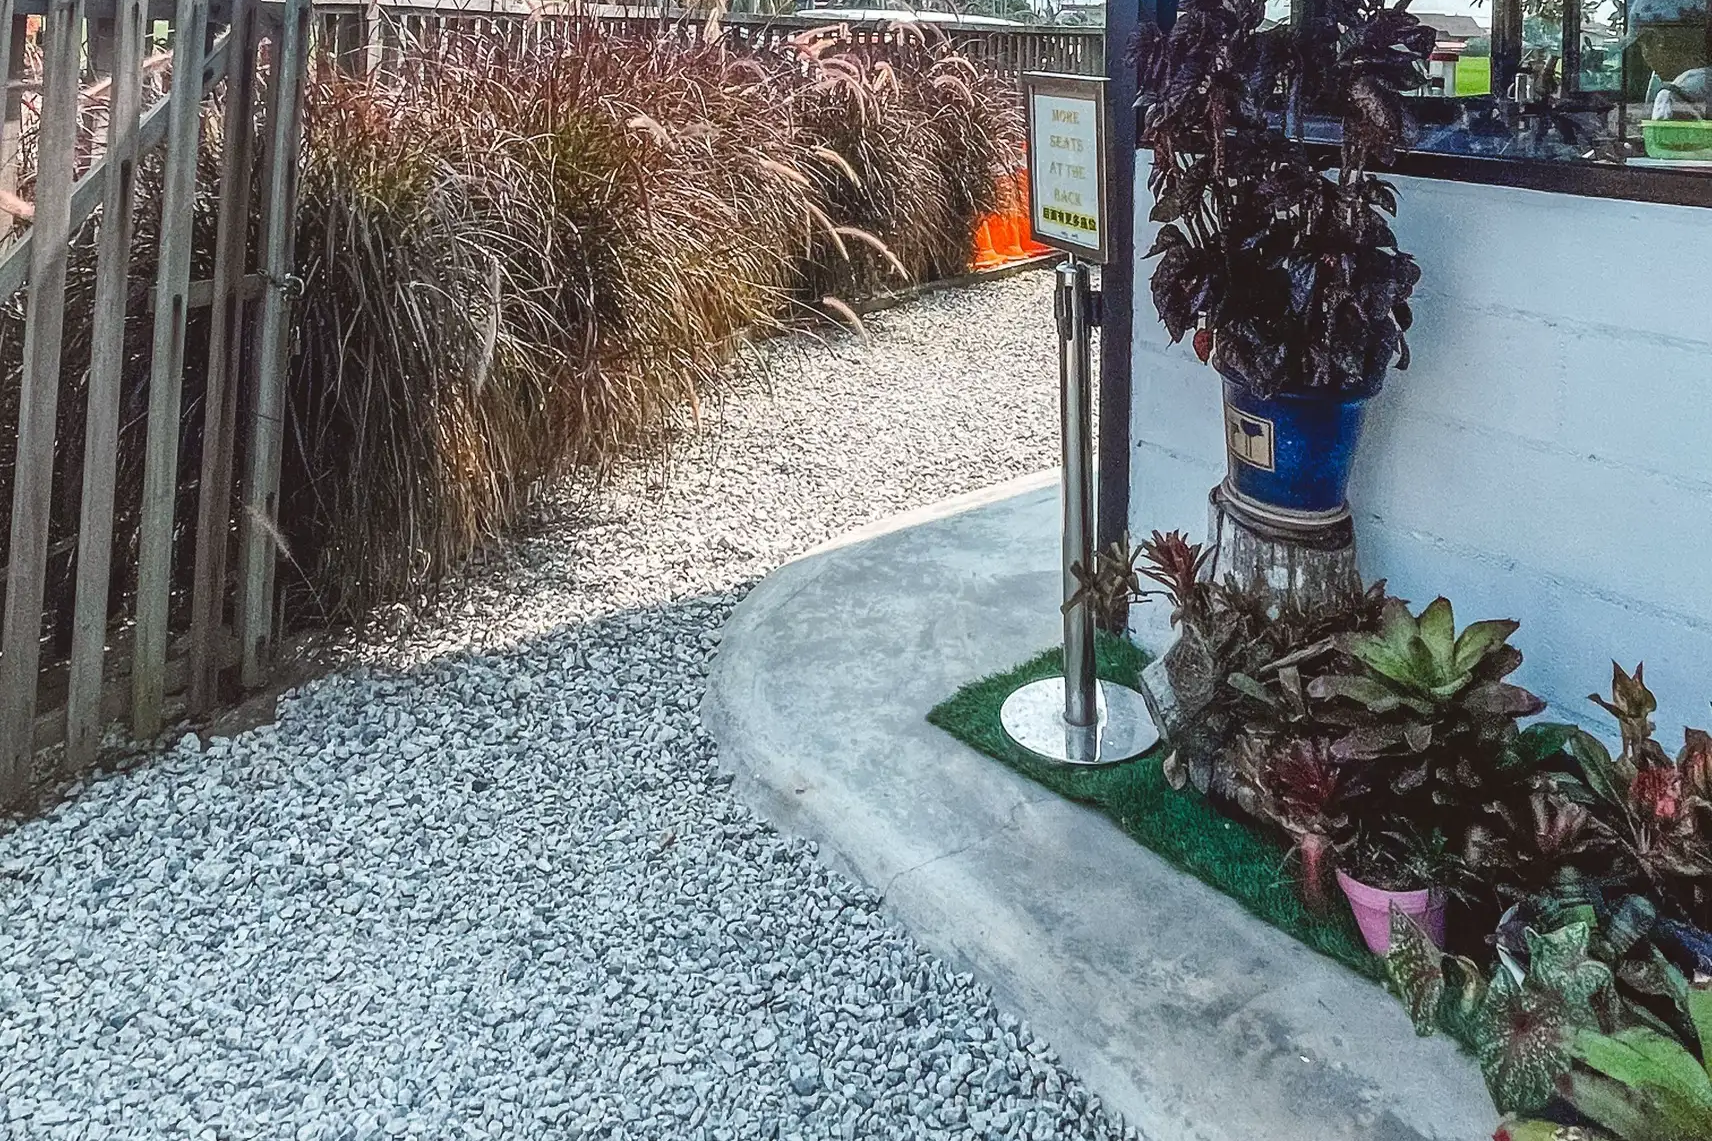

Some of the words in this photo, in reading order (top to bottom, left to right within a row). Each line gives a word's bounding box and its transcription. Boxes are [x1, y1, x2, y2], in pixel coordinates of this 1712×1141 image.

[1051, 109, 1080, 125] MORE
[1050, 134, 1083, 153] SEATS
[1050, 162, 1063, 177] AT
[1066, 164, 1086, 180] THE
[1054, 187, 1082, 206] BACK
